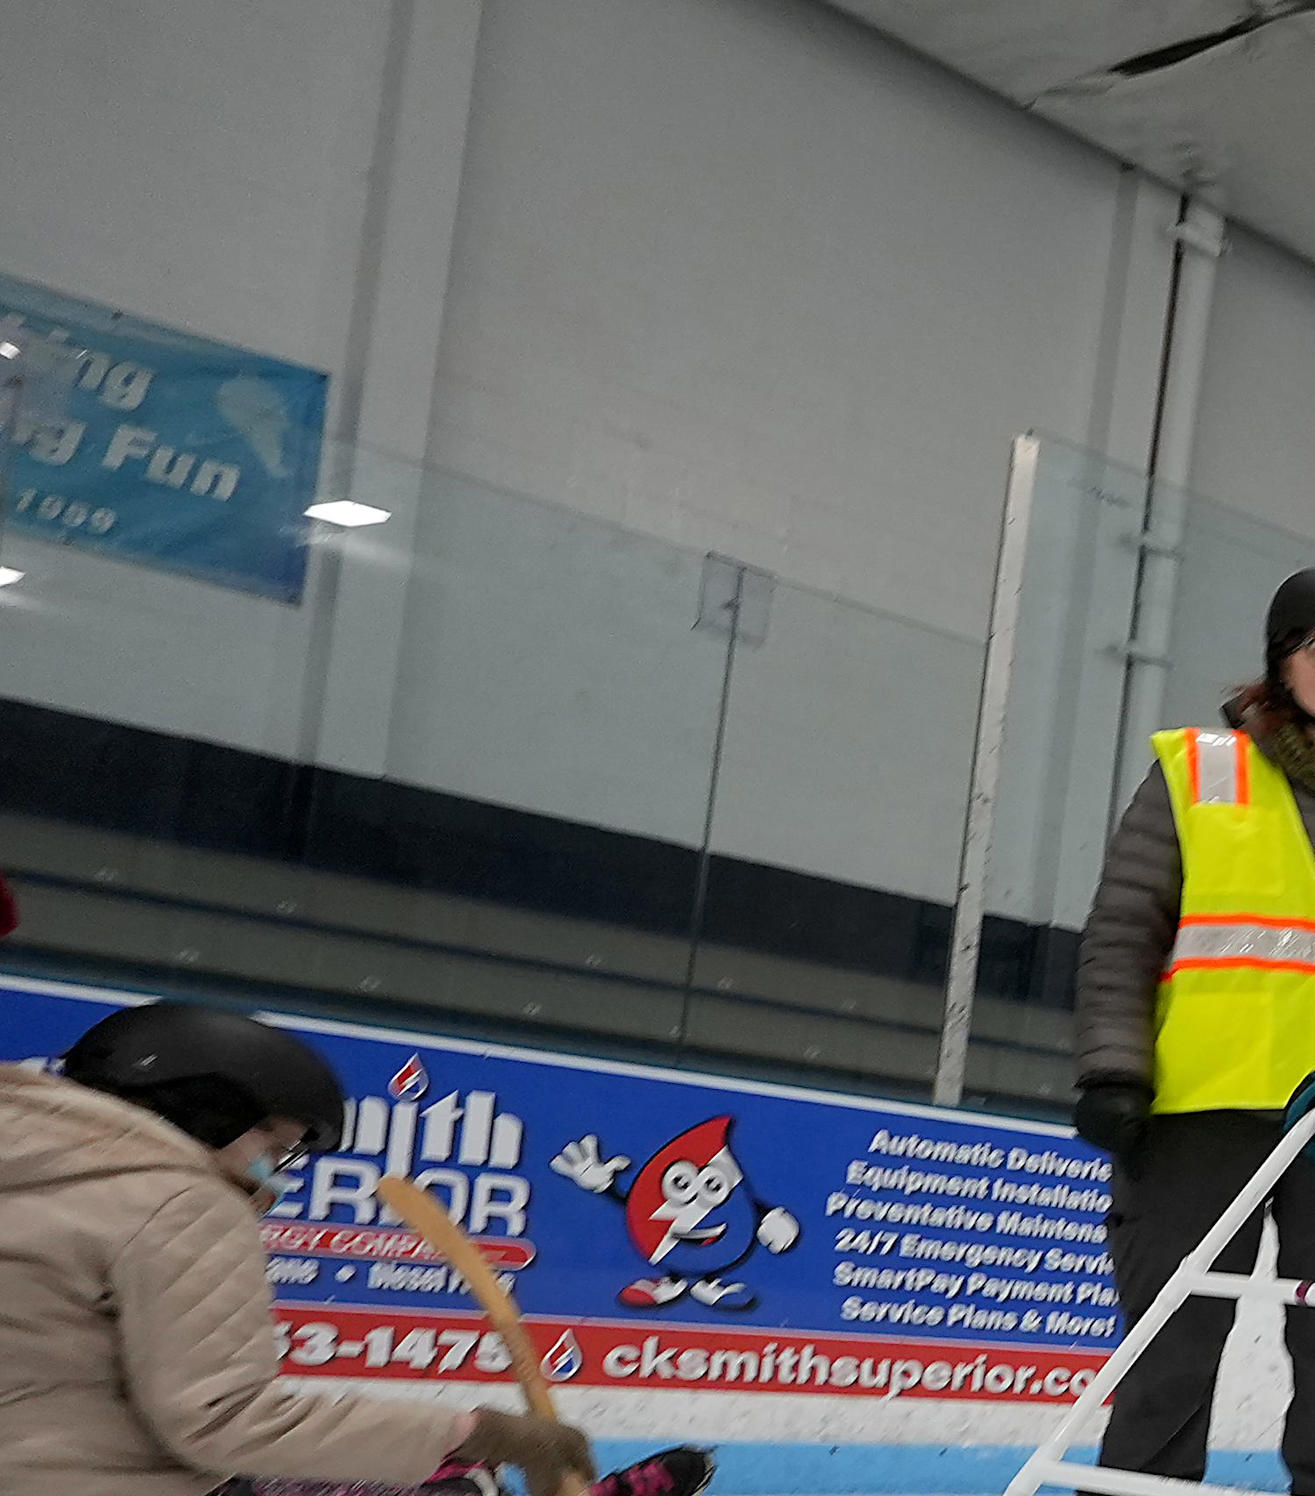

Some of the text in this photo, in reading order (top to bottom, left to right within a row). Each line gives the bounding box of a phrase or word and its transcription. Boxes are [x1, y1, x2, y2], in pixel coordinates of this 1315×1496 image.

[101, 423, 241, 502] Fun
[868, 1129, 1005, 1169] Automatic
[846, 1160, 1114, 1213] Equipment Installatio
[825, 1191, 995, 1233] Preventative
[834, 1228, 899, 1256] 24/7
[899, 1233, 1044, 1273] Emergency
[833, 1261, 966, 1299] SmartPay
[966, 1272, 1075, 1304] Payment
[840, 1295, 1118, 1338] Service Plans & More!
